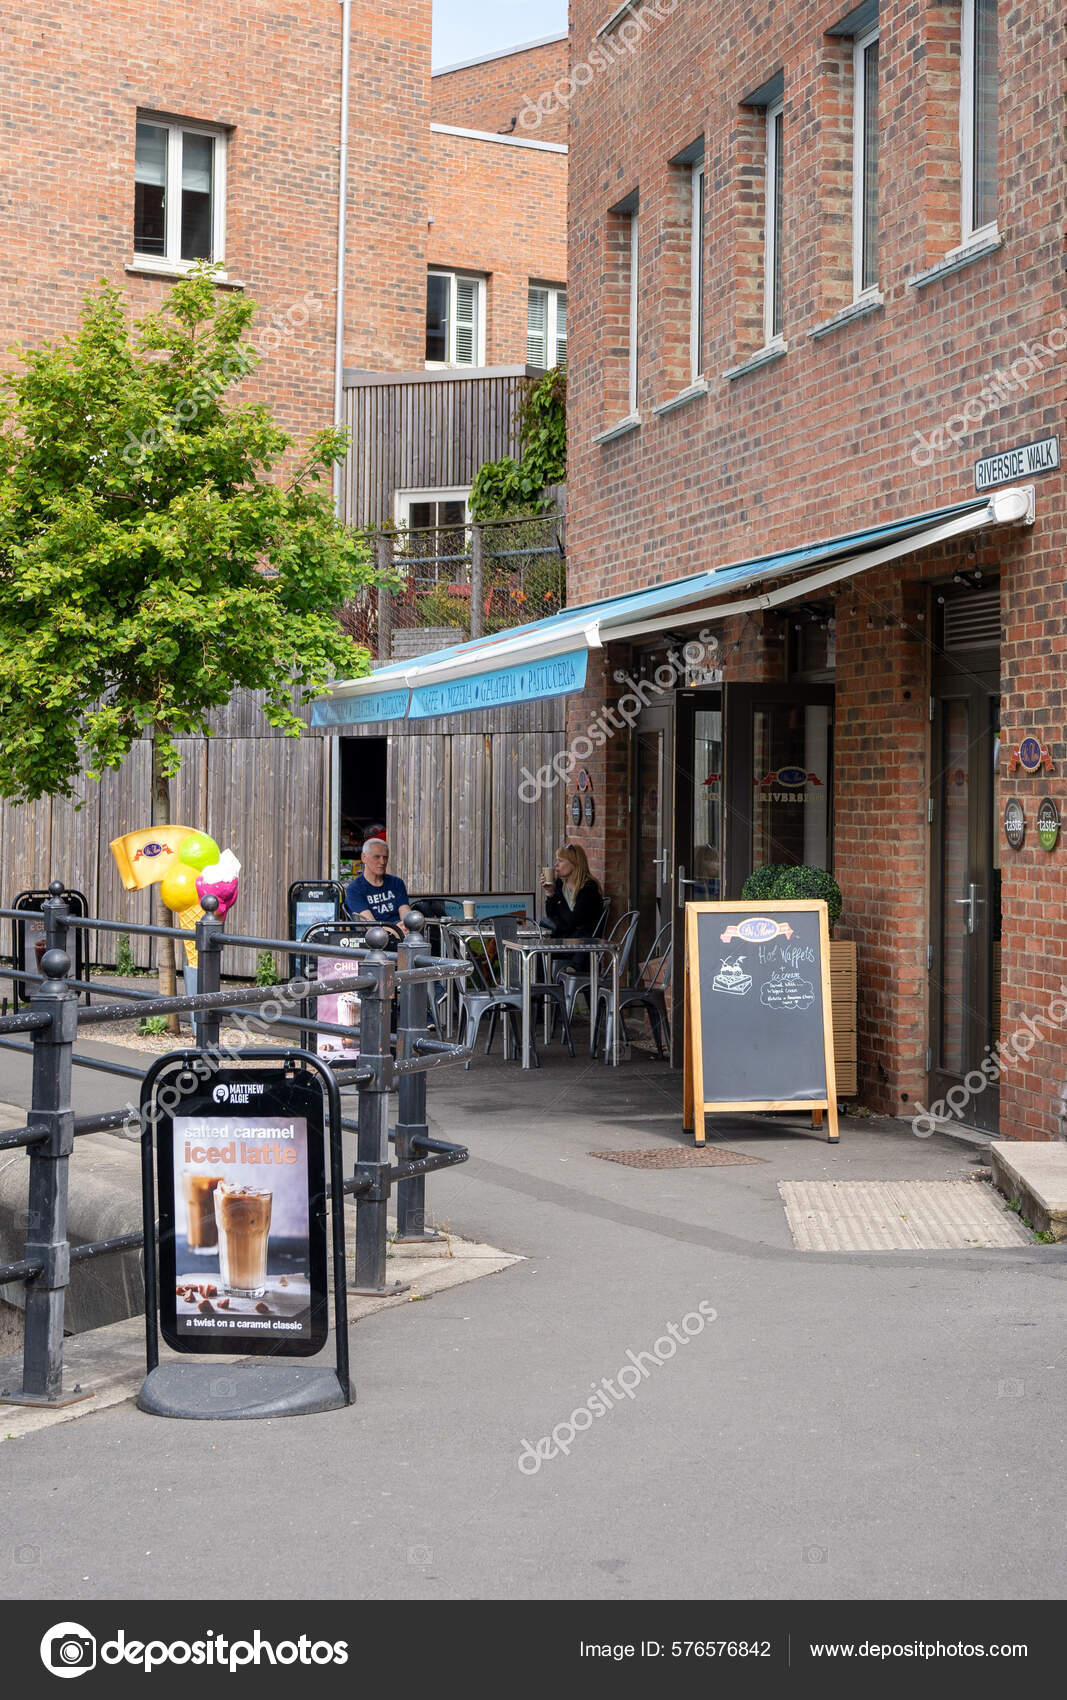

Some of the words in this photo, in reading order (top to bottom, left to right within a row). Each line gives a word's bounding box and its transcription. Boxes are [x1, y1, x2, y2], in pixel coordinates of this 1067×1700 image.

[978, 451, 1024, 486] RIVERSIDE
[1027, 441, 1053, 470] WALK
[1005, 820, 1024, 832] taste
[1038, 820, 1059, 832] taste
[367, 890, 396, 904] BELLA
[758, 944, 777, 964] Hot
[229, 1083, 264, 1094] MATTHEW
[230, 1093, 249, 1104] ALGIE
[184, 1125, 229, 1139] salted
[234, 1125, 295, 1139] caramel
[184, 1141, 236, 1164] iced
[240, 1141, 297, 1165] latte
[186, 1319, 192, 1327] a
[194, 1318, 216, 1327] twist
[217, 1320, 228, 1328] on
[229, 1320, 235, 1328] a
[236, 1320, 271, 1329] caramel
[272, 1321, 303, 1330] classic
